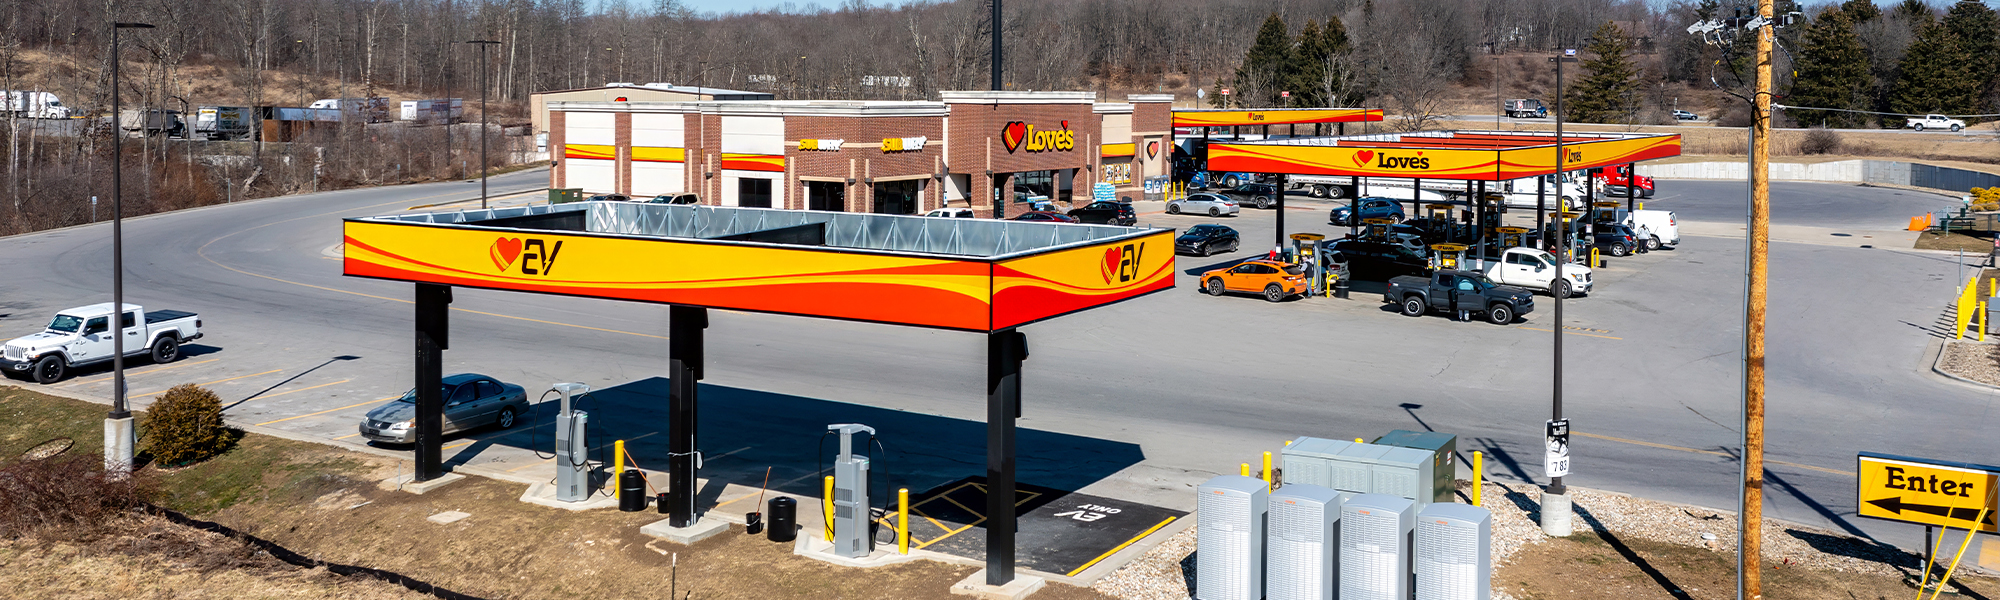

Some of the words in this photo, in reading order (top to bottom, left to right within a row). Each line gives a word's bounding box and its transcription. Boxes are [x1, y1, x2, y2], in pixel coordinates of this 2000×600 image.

[521, 238, 563, 276] EV
[1119, 241, 1145, 283] EV
[1885, 466, 1974, 498] Enter
[1053, 510, 1107, 522] EV
[1077, 503, 1122, 514] ONLY
